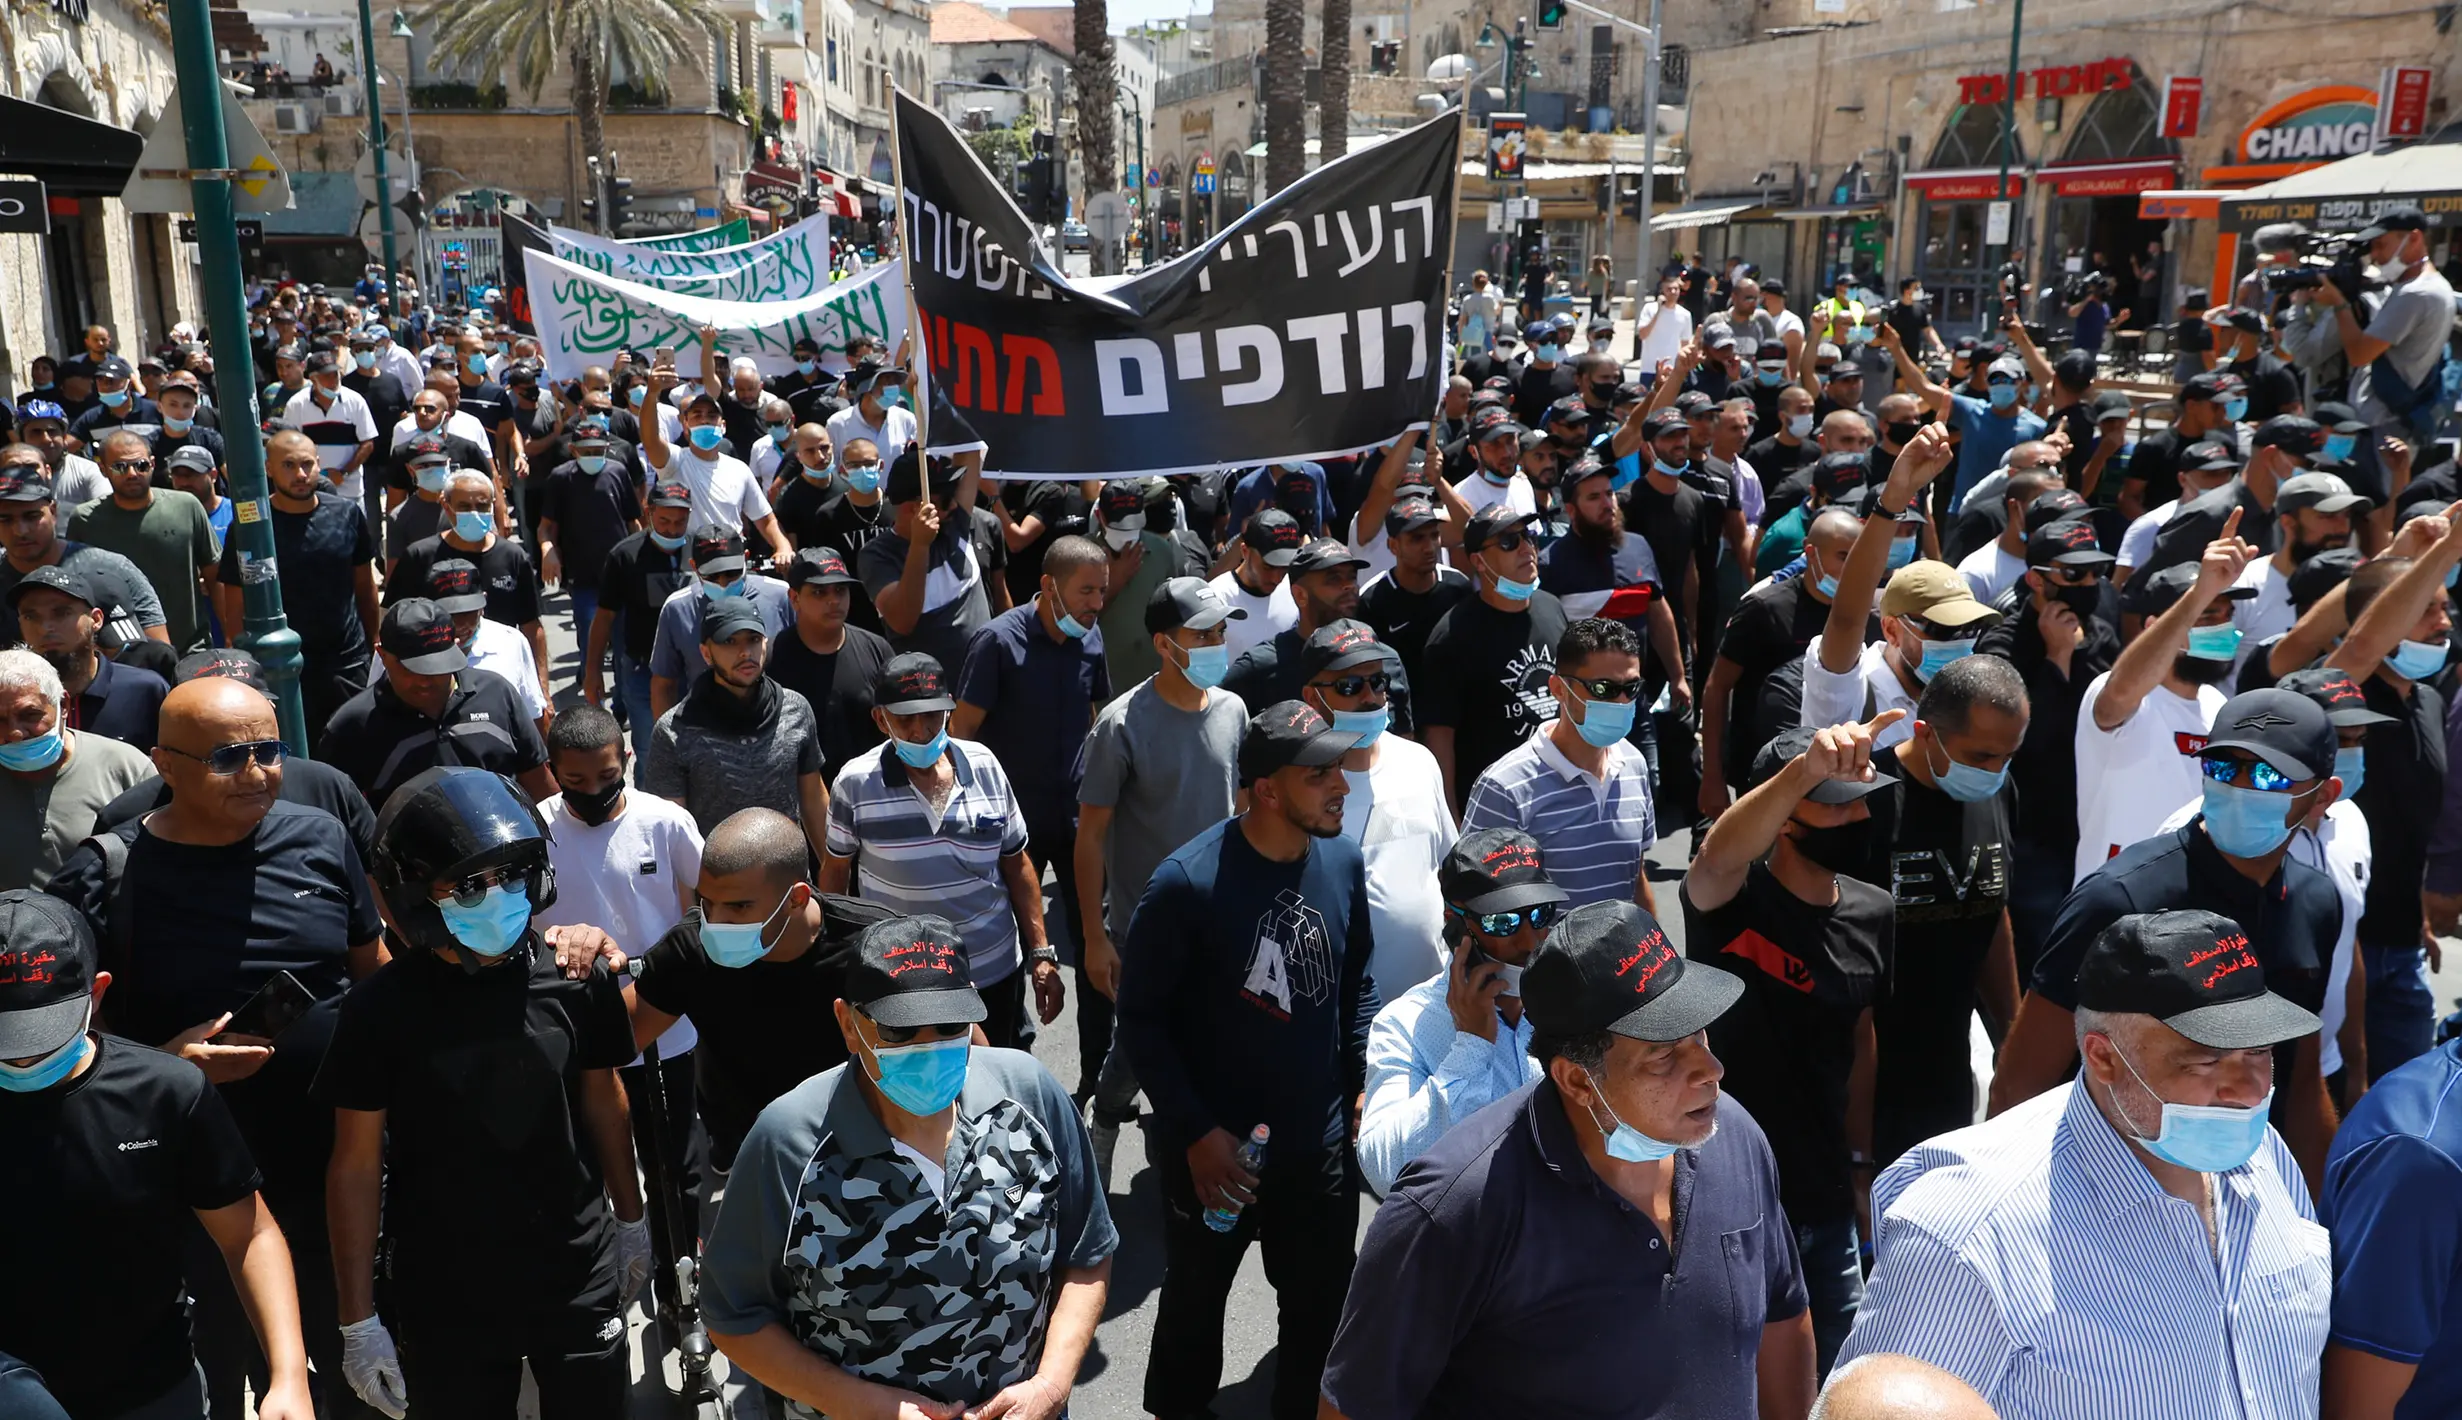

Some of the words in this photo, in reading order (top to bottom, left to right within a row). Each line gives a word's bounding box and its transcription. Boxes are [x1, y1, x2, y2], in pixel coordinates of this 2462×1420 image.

[1095, 300, 1428, 416] רודפים
[1500, 644, 1557, 692] ARMA
[928, 941, 956, 957] مقبرة
[930, 958, 953, 976] وقف
